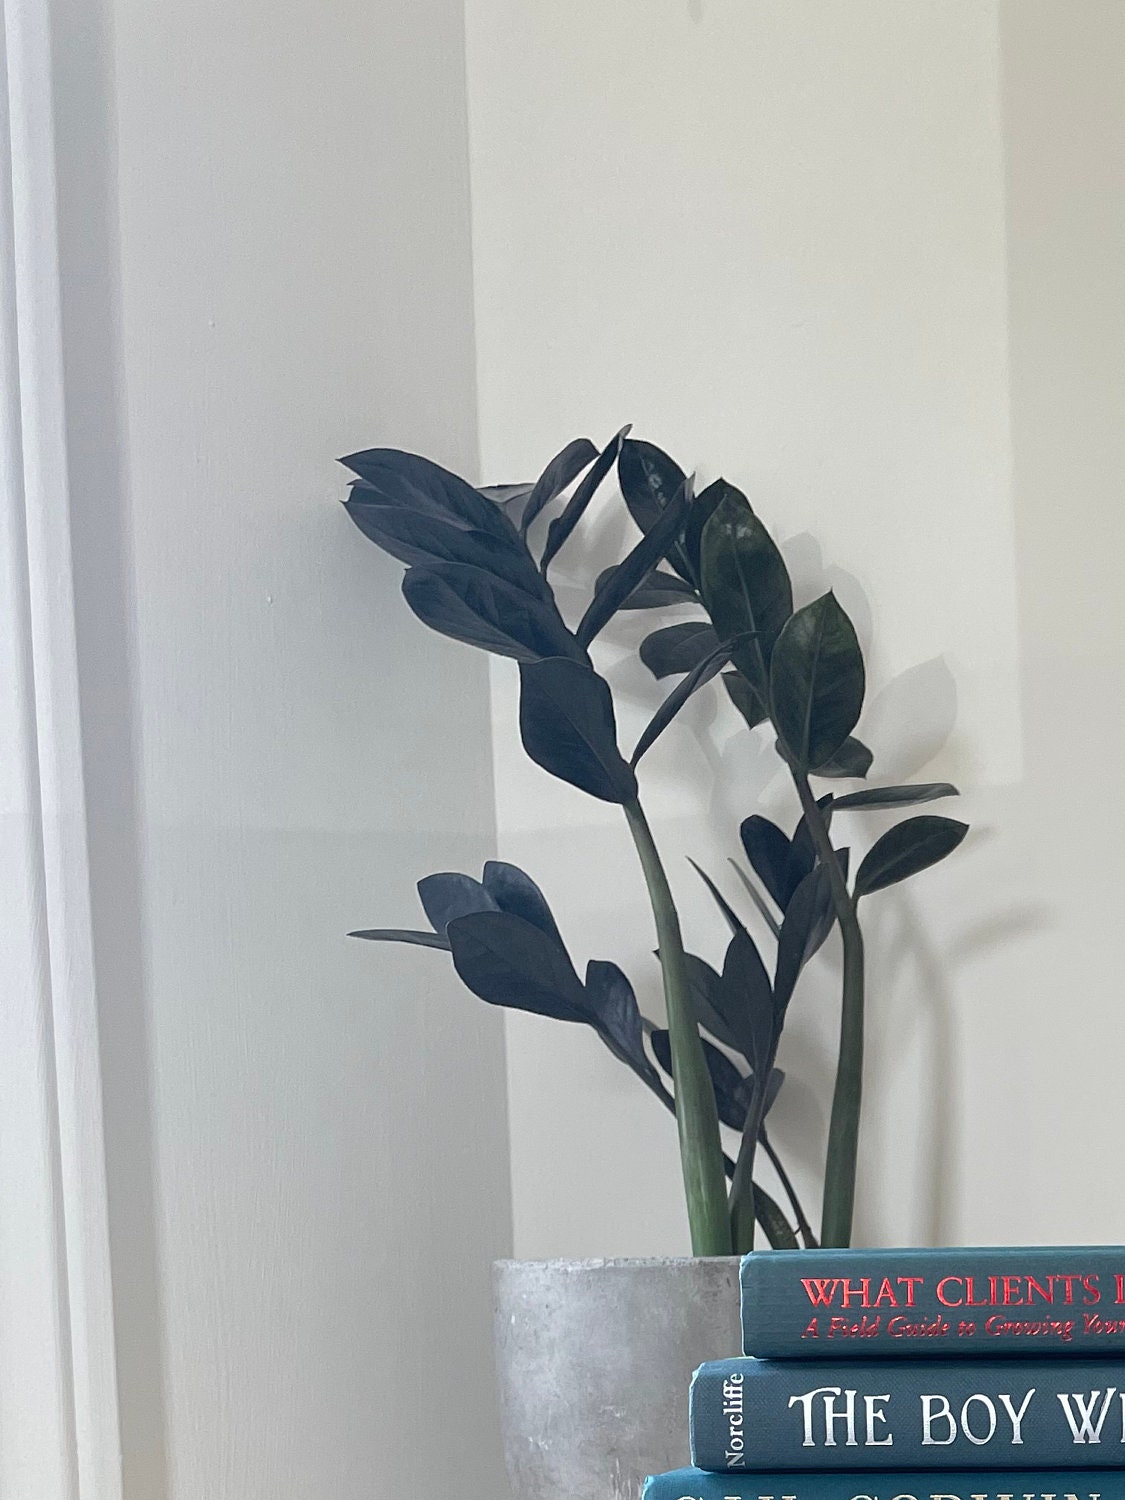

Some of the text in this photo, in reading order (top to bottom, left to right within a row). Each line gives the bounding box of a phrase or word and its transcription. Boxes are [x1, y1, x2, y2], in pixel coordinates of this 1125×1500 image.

[801, 1276, 924, 1309] WHAT
[936, 1274, 1102, 1308] CLIENTS
[801, 1317, 819, 1339] A
[829, 1315, 879, 1338] Field
[887, 1314, 950, 1338] Guide
[957, 1320, 977, 1337] to
[984, 1314, 1076, 1342] Growing
[722, 1372, 745, 1469] Norcliffe
[787, 1386, 893, 1447] THE
[919, 1388, 1036, 1445] BOY
